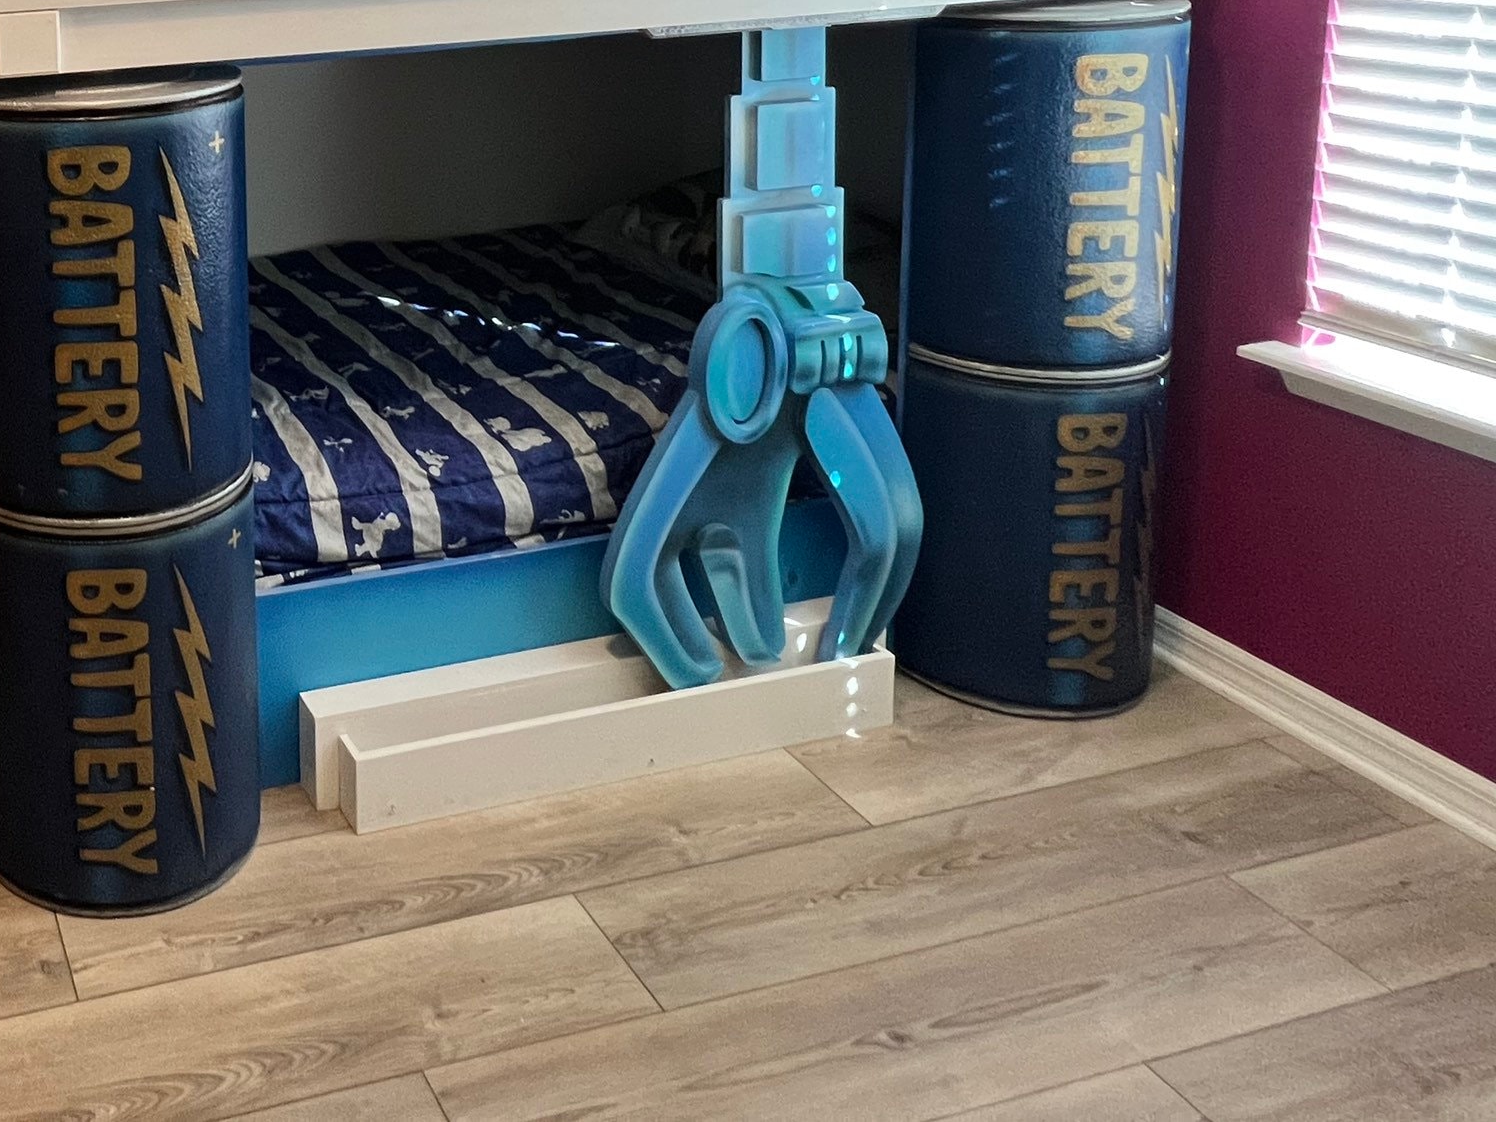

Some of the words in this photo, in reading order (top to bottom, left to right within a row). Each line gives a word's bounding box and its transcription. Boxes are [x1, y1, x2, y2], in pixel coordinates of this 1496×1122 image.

[46, 144, 142, 482] BATTERY
[1064, 52, 1149, 341] BATTERY
[1048, 412, 1128, 680] BATTERY
[66, 568, 157, 875] BATTERY
